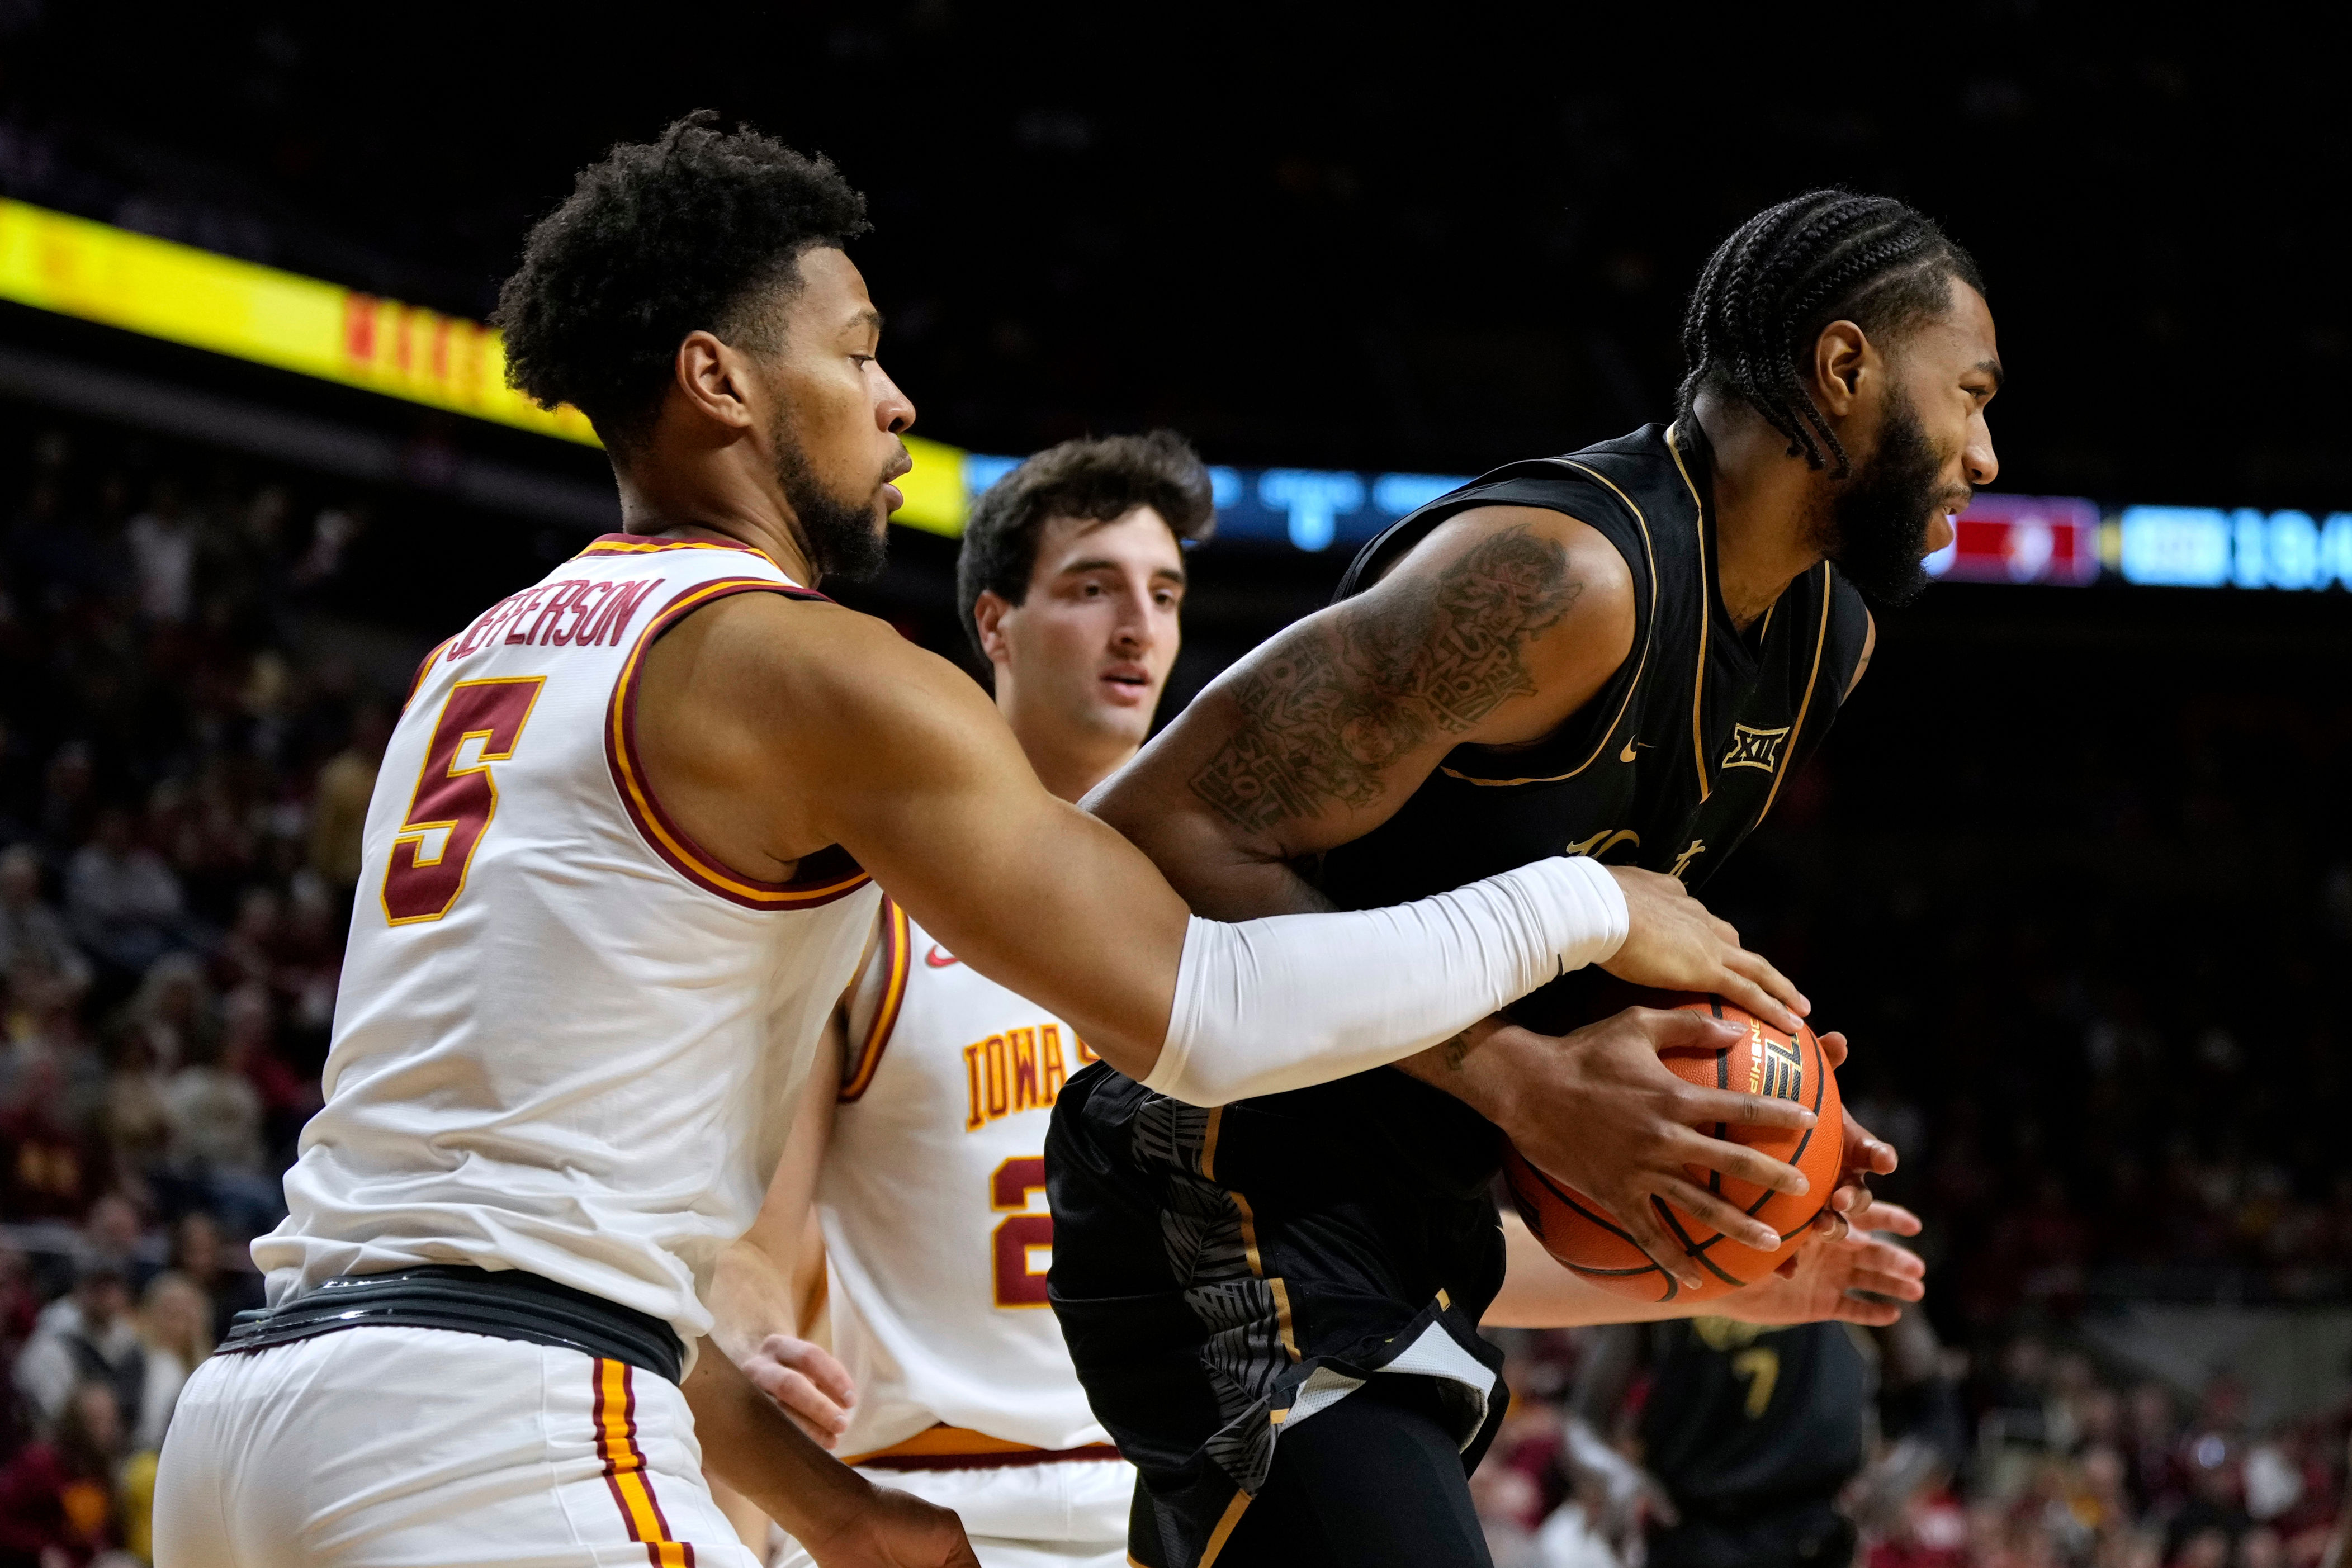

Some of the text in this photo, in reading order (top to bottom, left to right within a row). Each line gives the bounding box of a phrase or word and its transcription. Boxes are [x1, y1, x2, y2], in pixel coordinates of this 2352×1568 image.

[447, 578, 666, 662] JEFFERSON
[1724, 728, 1786, 768] XII
[380, 675, 547, 927] 5
[963, 1023, 1068, 1133] IOWA
[1734, 1347, 1780, 1419] 7
